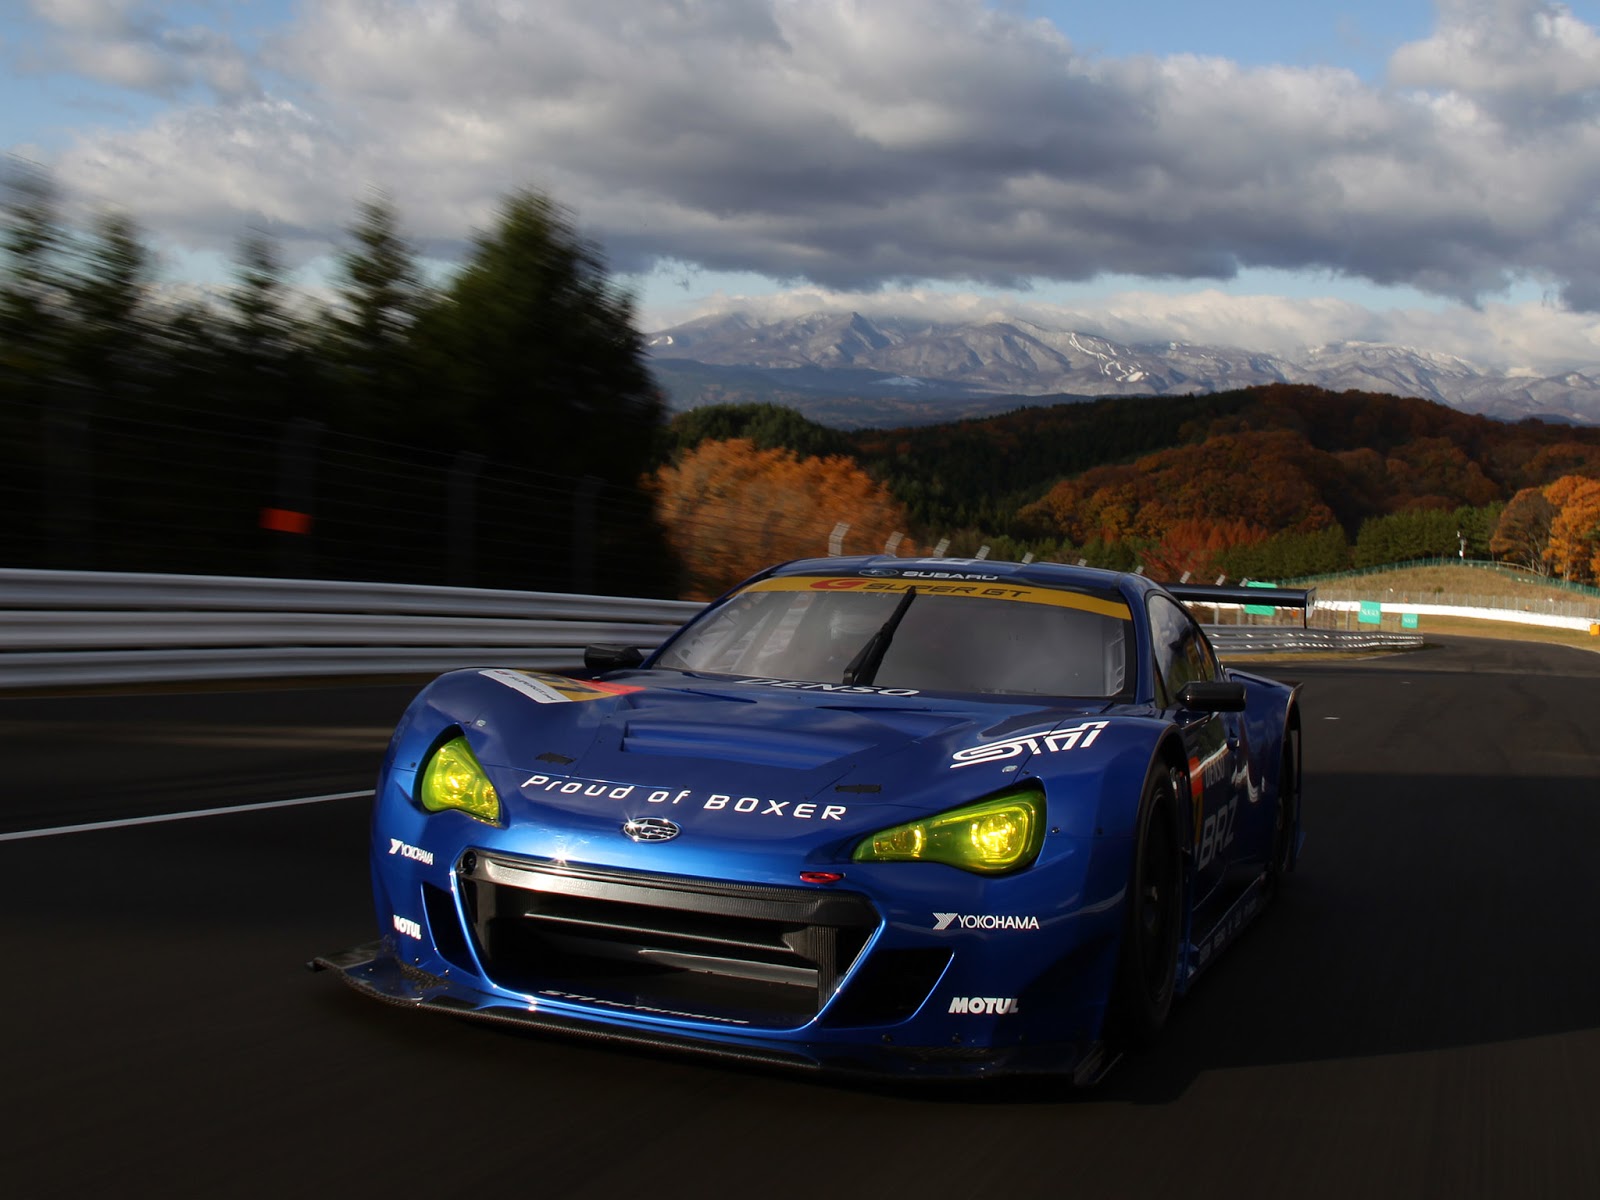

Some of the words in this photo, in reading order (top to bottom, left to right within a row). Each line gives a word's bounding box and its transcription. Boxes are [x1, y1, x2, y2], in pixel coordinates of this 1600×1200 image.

[902, 570, 999, 581] SUBARU
[863, 582, 972, 595] SUPER
[980, 588, 1032, 599] GT
[734, 678, 920, 696] DENSO
[520, 775, 635, 800] Proud
[647, 790, 691, 804] of
[703, 794, 847, 821] BOXER
[1197, 793, 1239, 873] BRZ
[400, 842, 434, 866] YOKOHAMA
[393, 914, 422, 940] MOTUL
[957, 914, 1040, 930] YOKOHAMA
[948, 996, 1019, 1015] MOTUL
